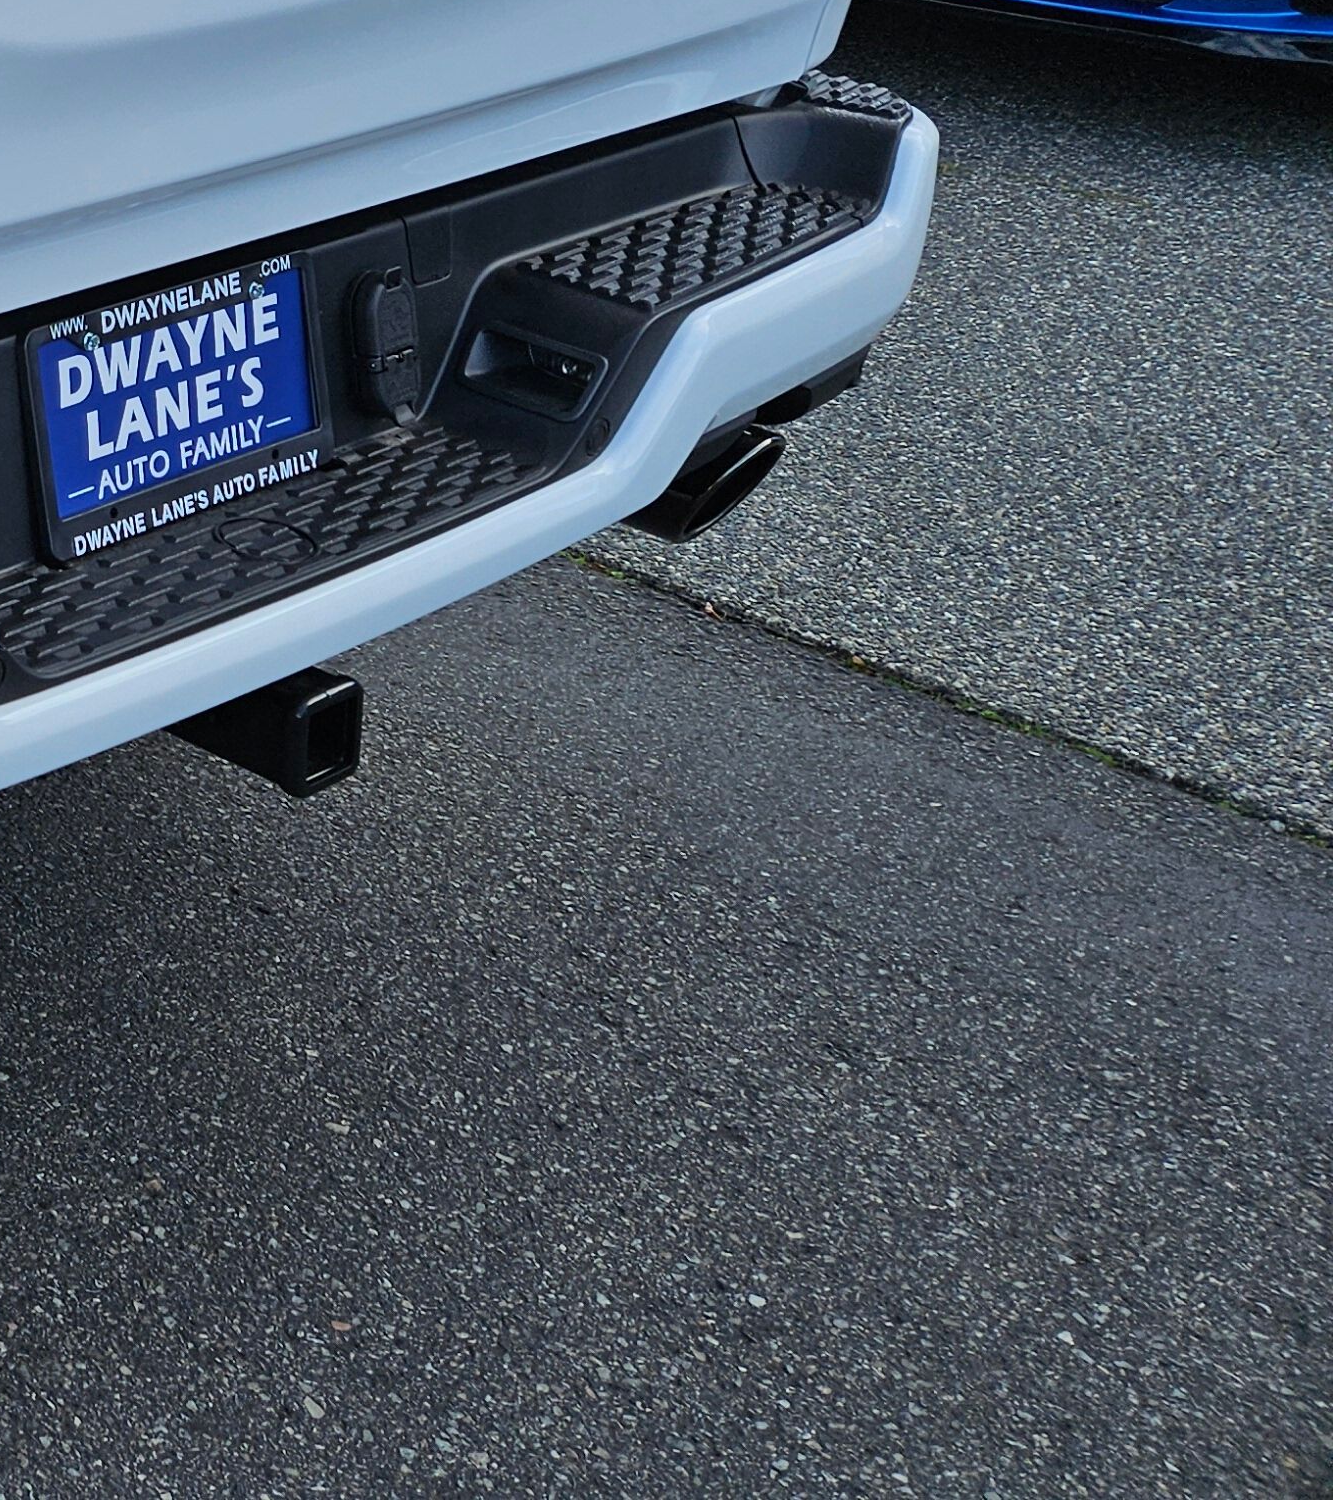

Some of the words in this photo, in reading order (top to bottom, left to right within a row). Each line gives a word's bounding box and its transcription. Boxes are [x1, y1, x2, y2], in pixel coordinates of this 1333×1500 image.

[58, 292, 280, 410] DWAYNE
[101, 271, 242, 334] DWAYNELANE
[86, 356, 265, 462] LANE'S
[98, 450, 171, 500] AUTO
[180, 415, 265, 470] FAMILY
[73, 514, 147, 557] DWAYNE
[151, 490, 209, 527] LANE'S
[212, 473, 255, 505] AUTO
[257, 449, 319, 485] FAMILY
